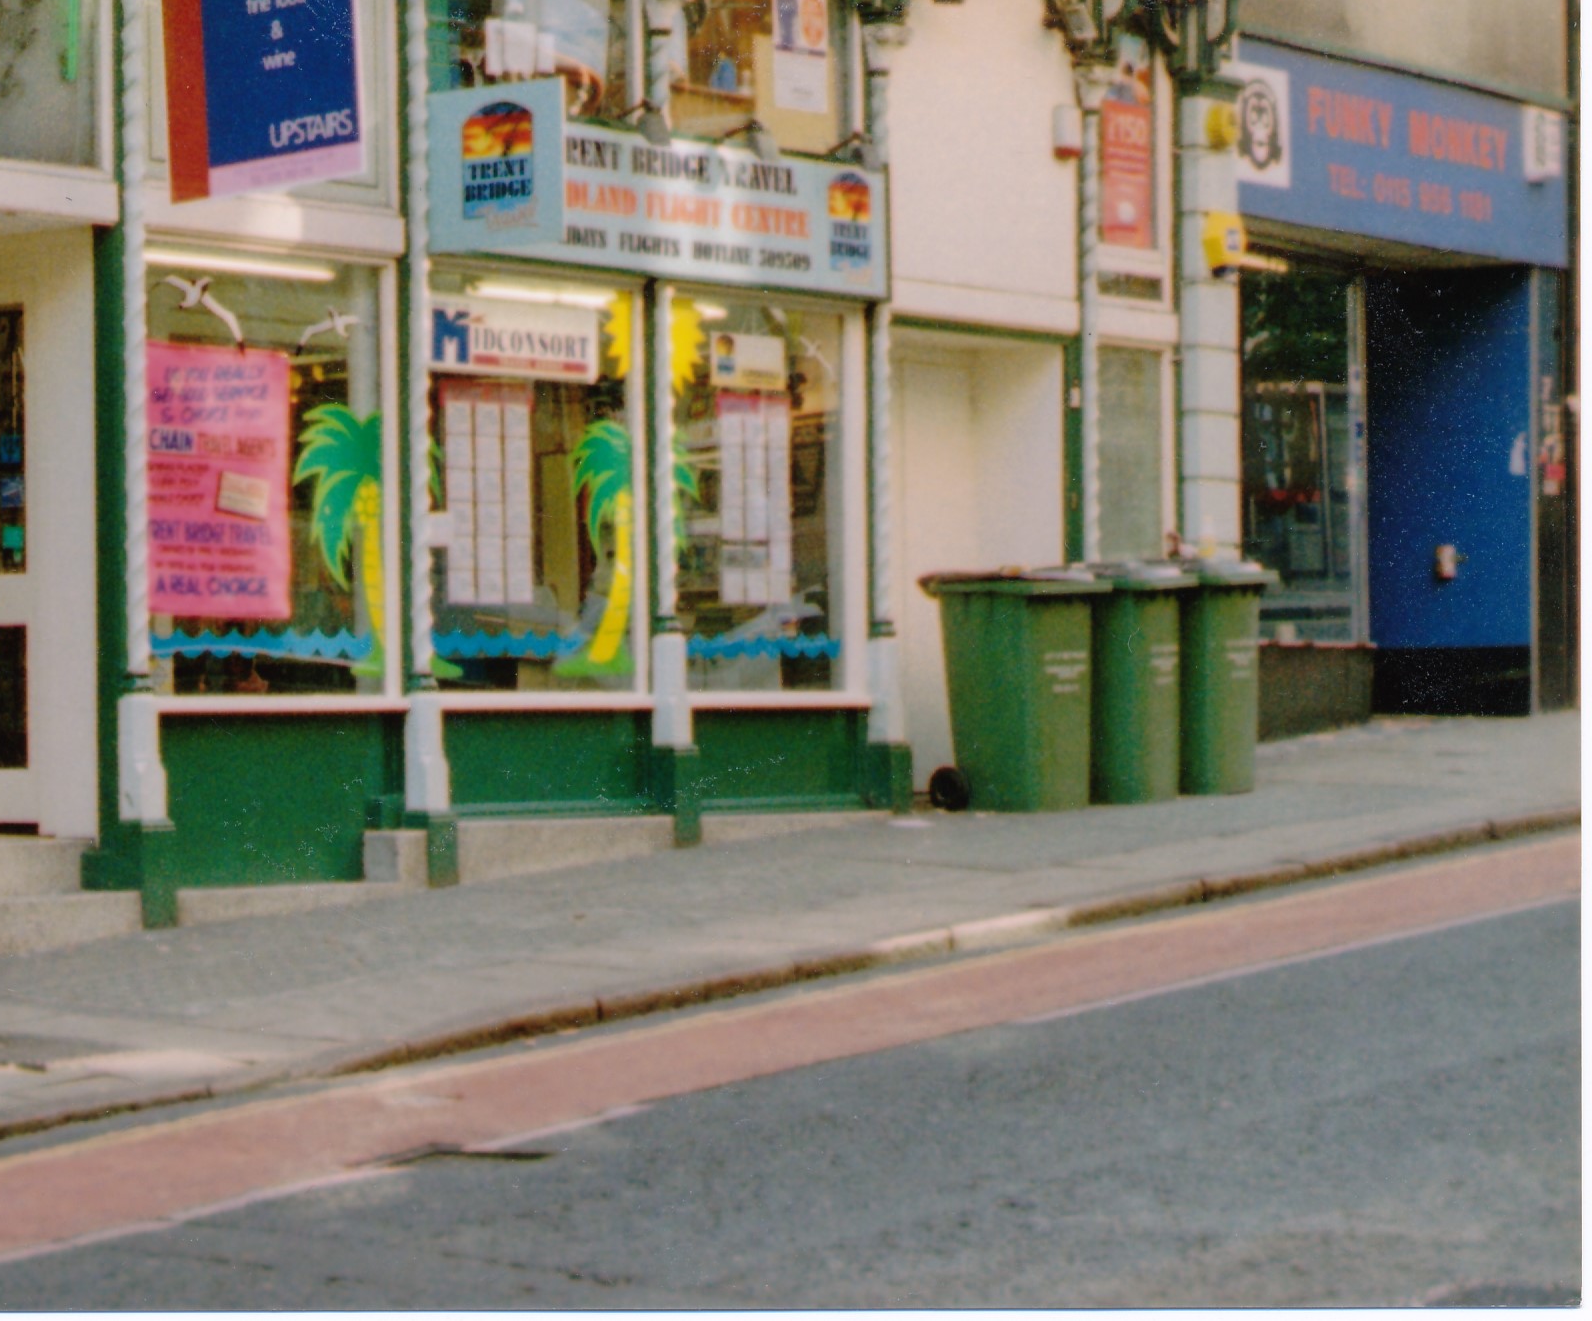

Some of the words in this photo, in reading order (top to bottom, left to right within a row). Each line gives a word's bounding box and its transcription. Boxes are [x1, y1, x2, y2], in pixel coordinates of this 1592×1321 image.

[270, 19, 284, 40] &
[262, 50, 296, 71] wine
[269, 108, 353, 148] UPSTAIRS
[1307, 85, 1393, 150] FUNKY
[1409, 109, 1507, 173] MONKEY
[467, 158, 528, 181] TRENT
[631, 145, 712, 186] BRIDGE
[465, 178, 532, 203] BRIDGE
[645, 190, 722, 228] FLIGHT
[731, 201, 812, 237] CENTRE
[619, 231, 680, 257] FLIGHTS
[693, 240, 754, 265] HOTLINE
[431, 306, 589, 364] MIDCONSORT
[150, 427, 195, 452] CHAIN
[207, 574, 270, 597] CHOICE
